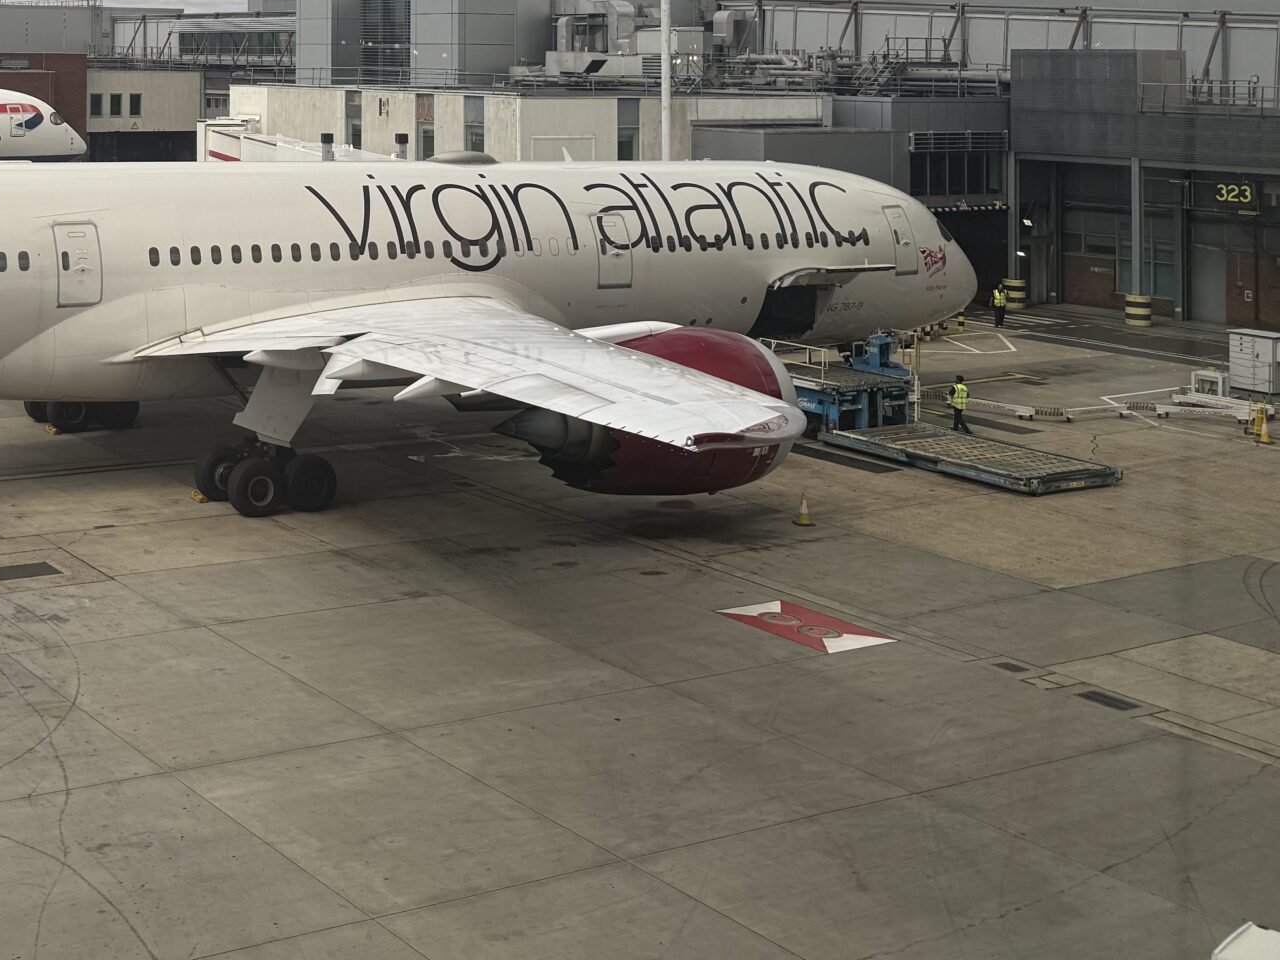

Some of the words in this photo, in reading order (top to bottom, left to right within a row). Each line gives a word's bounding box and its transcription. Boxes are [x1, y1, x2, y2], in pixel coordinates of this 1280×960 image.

[304, 173, 578, 271] virgin
[583, 171, 869, 250] atlantic
[1215, 184, 1252, 203] 323
